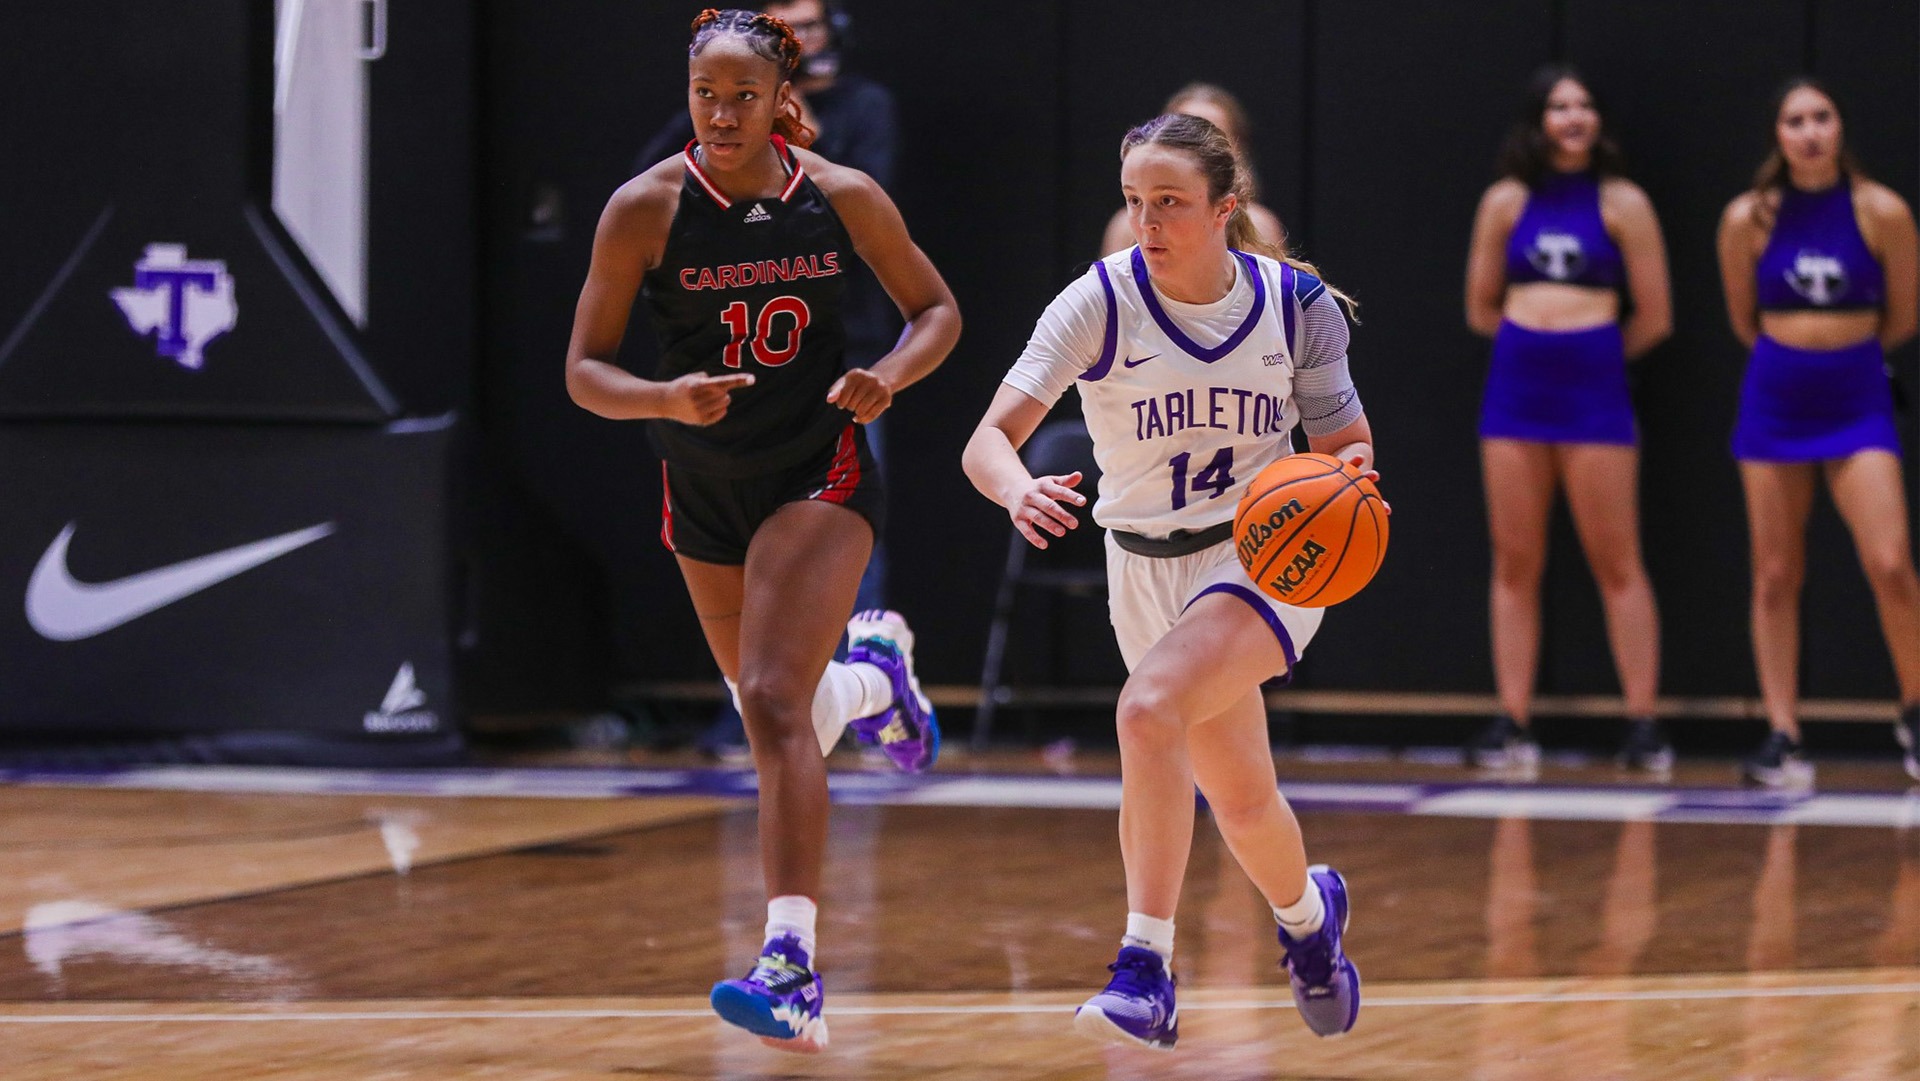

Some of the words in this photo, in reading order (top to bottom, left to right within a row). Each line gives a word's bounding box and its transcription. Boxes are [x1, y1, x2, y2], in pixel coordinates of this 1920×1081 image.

[743, 213, 771, 223] adidas
[679, 252, 839, 290] CARDINALS
[135, 271, 215, 355] T
[720, 295, 810, 368] 10
[1168, 446, 1235, 511] 14
[1270, 539, 1327, 597] NCAA
